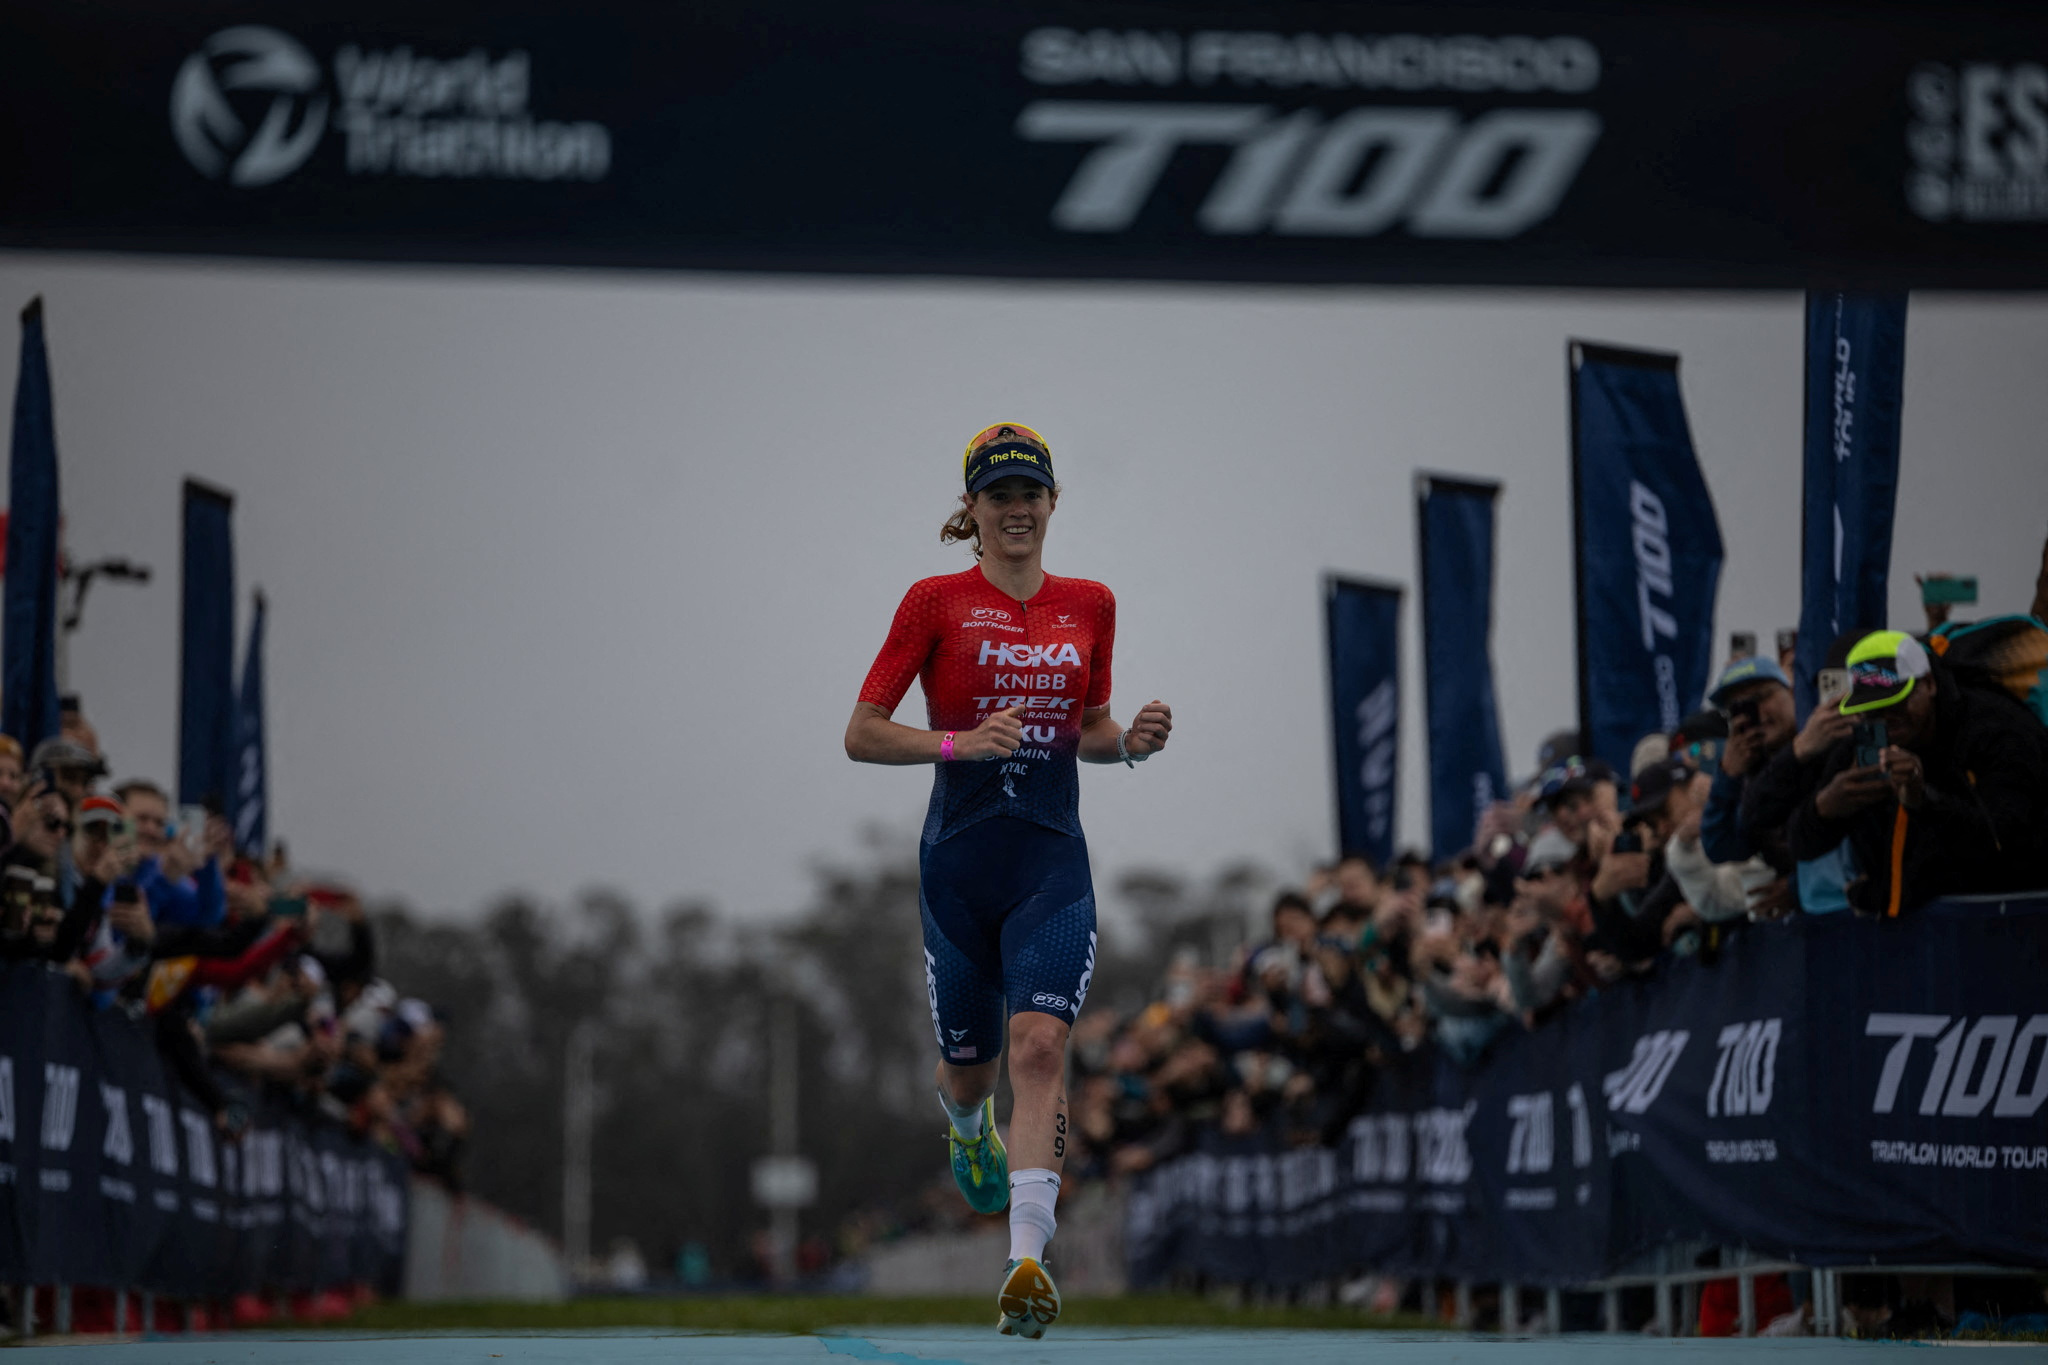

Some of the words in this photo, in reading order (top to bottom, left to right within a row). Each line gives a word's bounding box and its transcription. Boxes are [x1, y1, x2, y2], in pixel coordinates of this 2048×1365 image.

[1019, 27, 1183, 87] SAN
[1187, 31, 1600, 93] FRANCISCO
[1014, 101, 1601, 240] T100
[989, 452, 1009, 465] The
[1010, 450, 1039, 465] Feed.
[1630, 478, 1679, 652] T100
[962, 621, 1025, 633] BONTRAGER
[978, 640, 1081, 668] HOKA
[994, 673, 1067, 690] KNIBB
[972, 695, 1078, 710] TREK
[1027, 711, 1067, 720] RACING
[1000, 762, 1028, 776] NYAC
[1034, 994, 1067, 1009] PTO
[1865, 1013, 2048, 1118] T100
[1941, 1143, 1998, 1169] WORLD
[2001, 1145, 2048, 1169] TOUR
